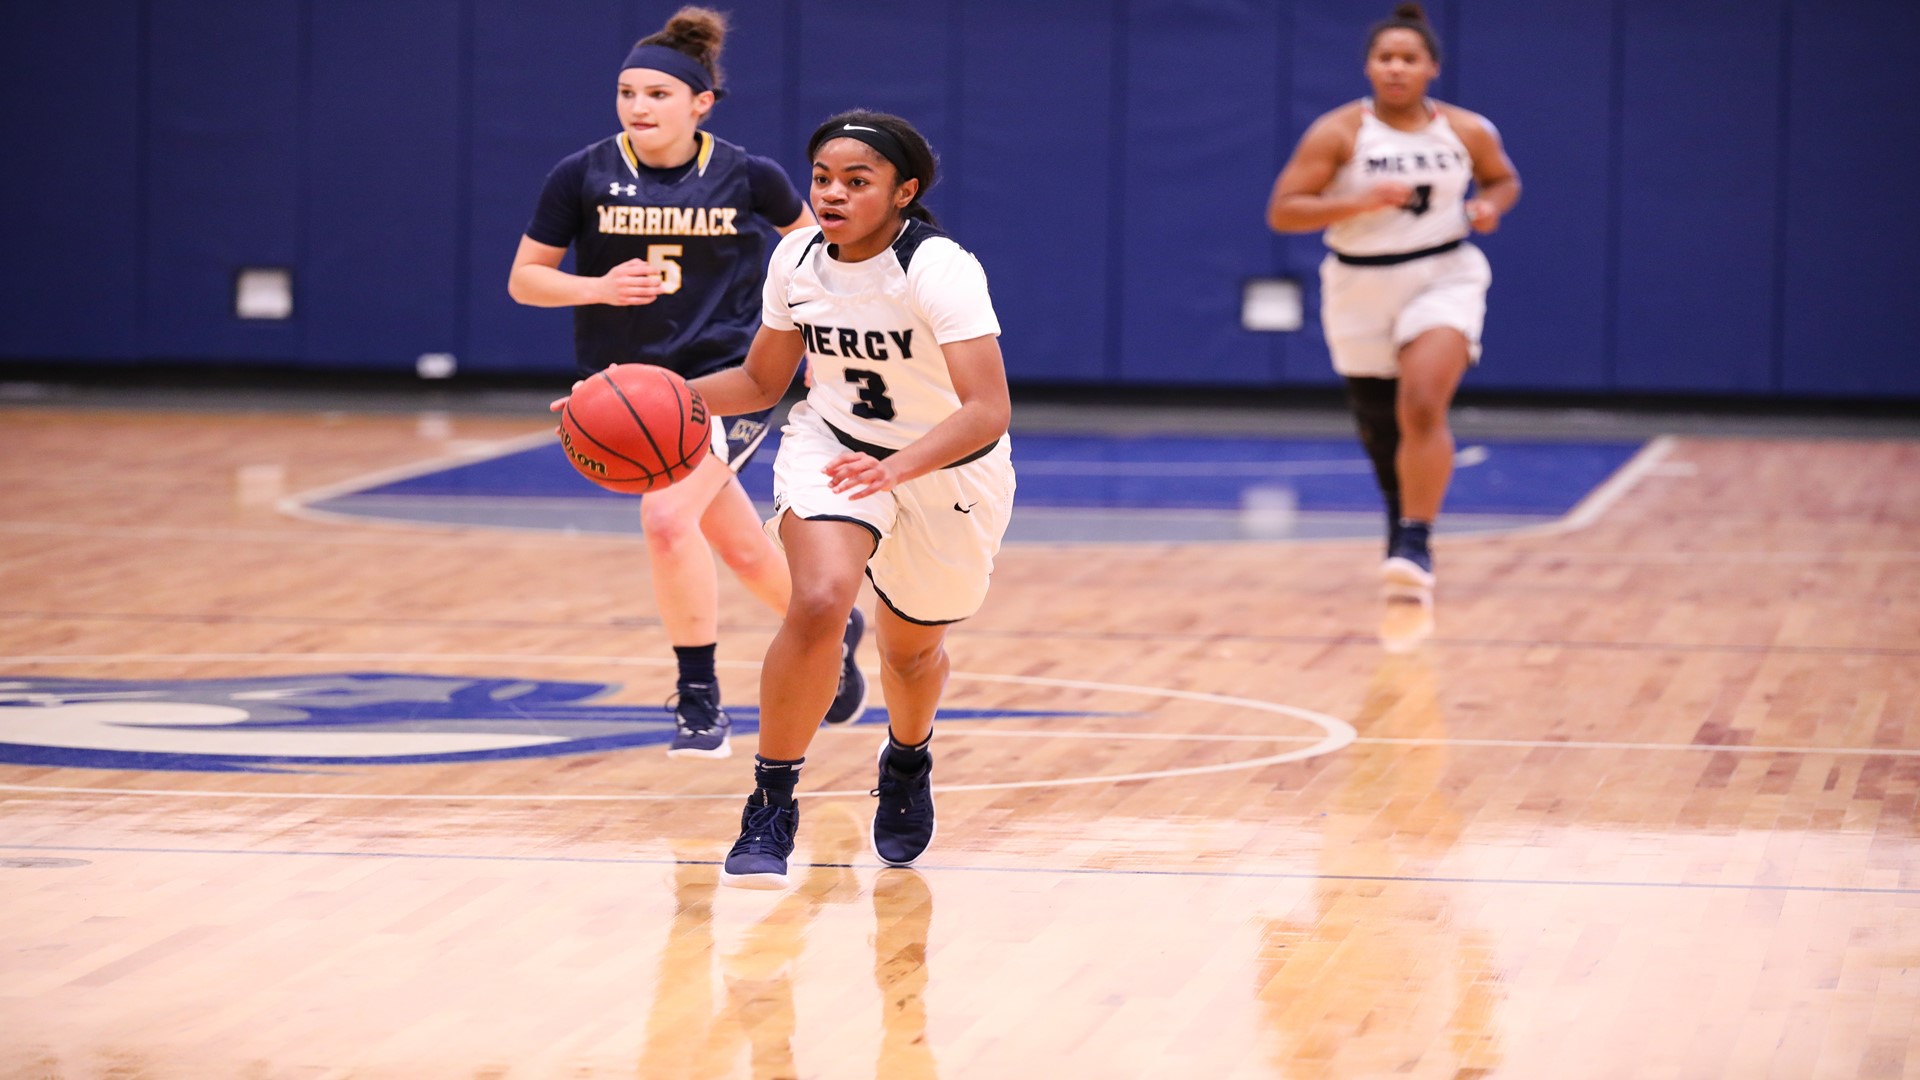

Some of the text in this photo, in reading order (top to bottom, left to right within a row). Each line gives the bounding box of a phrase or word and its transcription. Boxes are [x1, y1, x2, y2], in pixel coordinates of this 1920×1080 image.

[597, 205, 738, 236] MERRIMACK
[647, 244, 683, 295] 5
[793, 322, 914, 361] MERCY
[844, 367, 897, 421] 3
[560, 422, 608, 477] ilson
